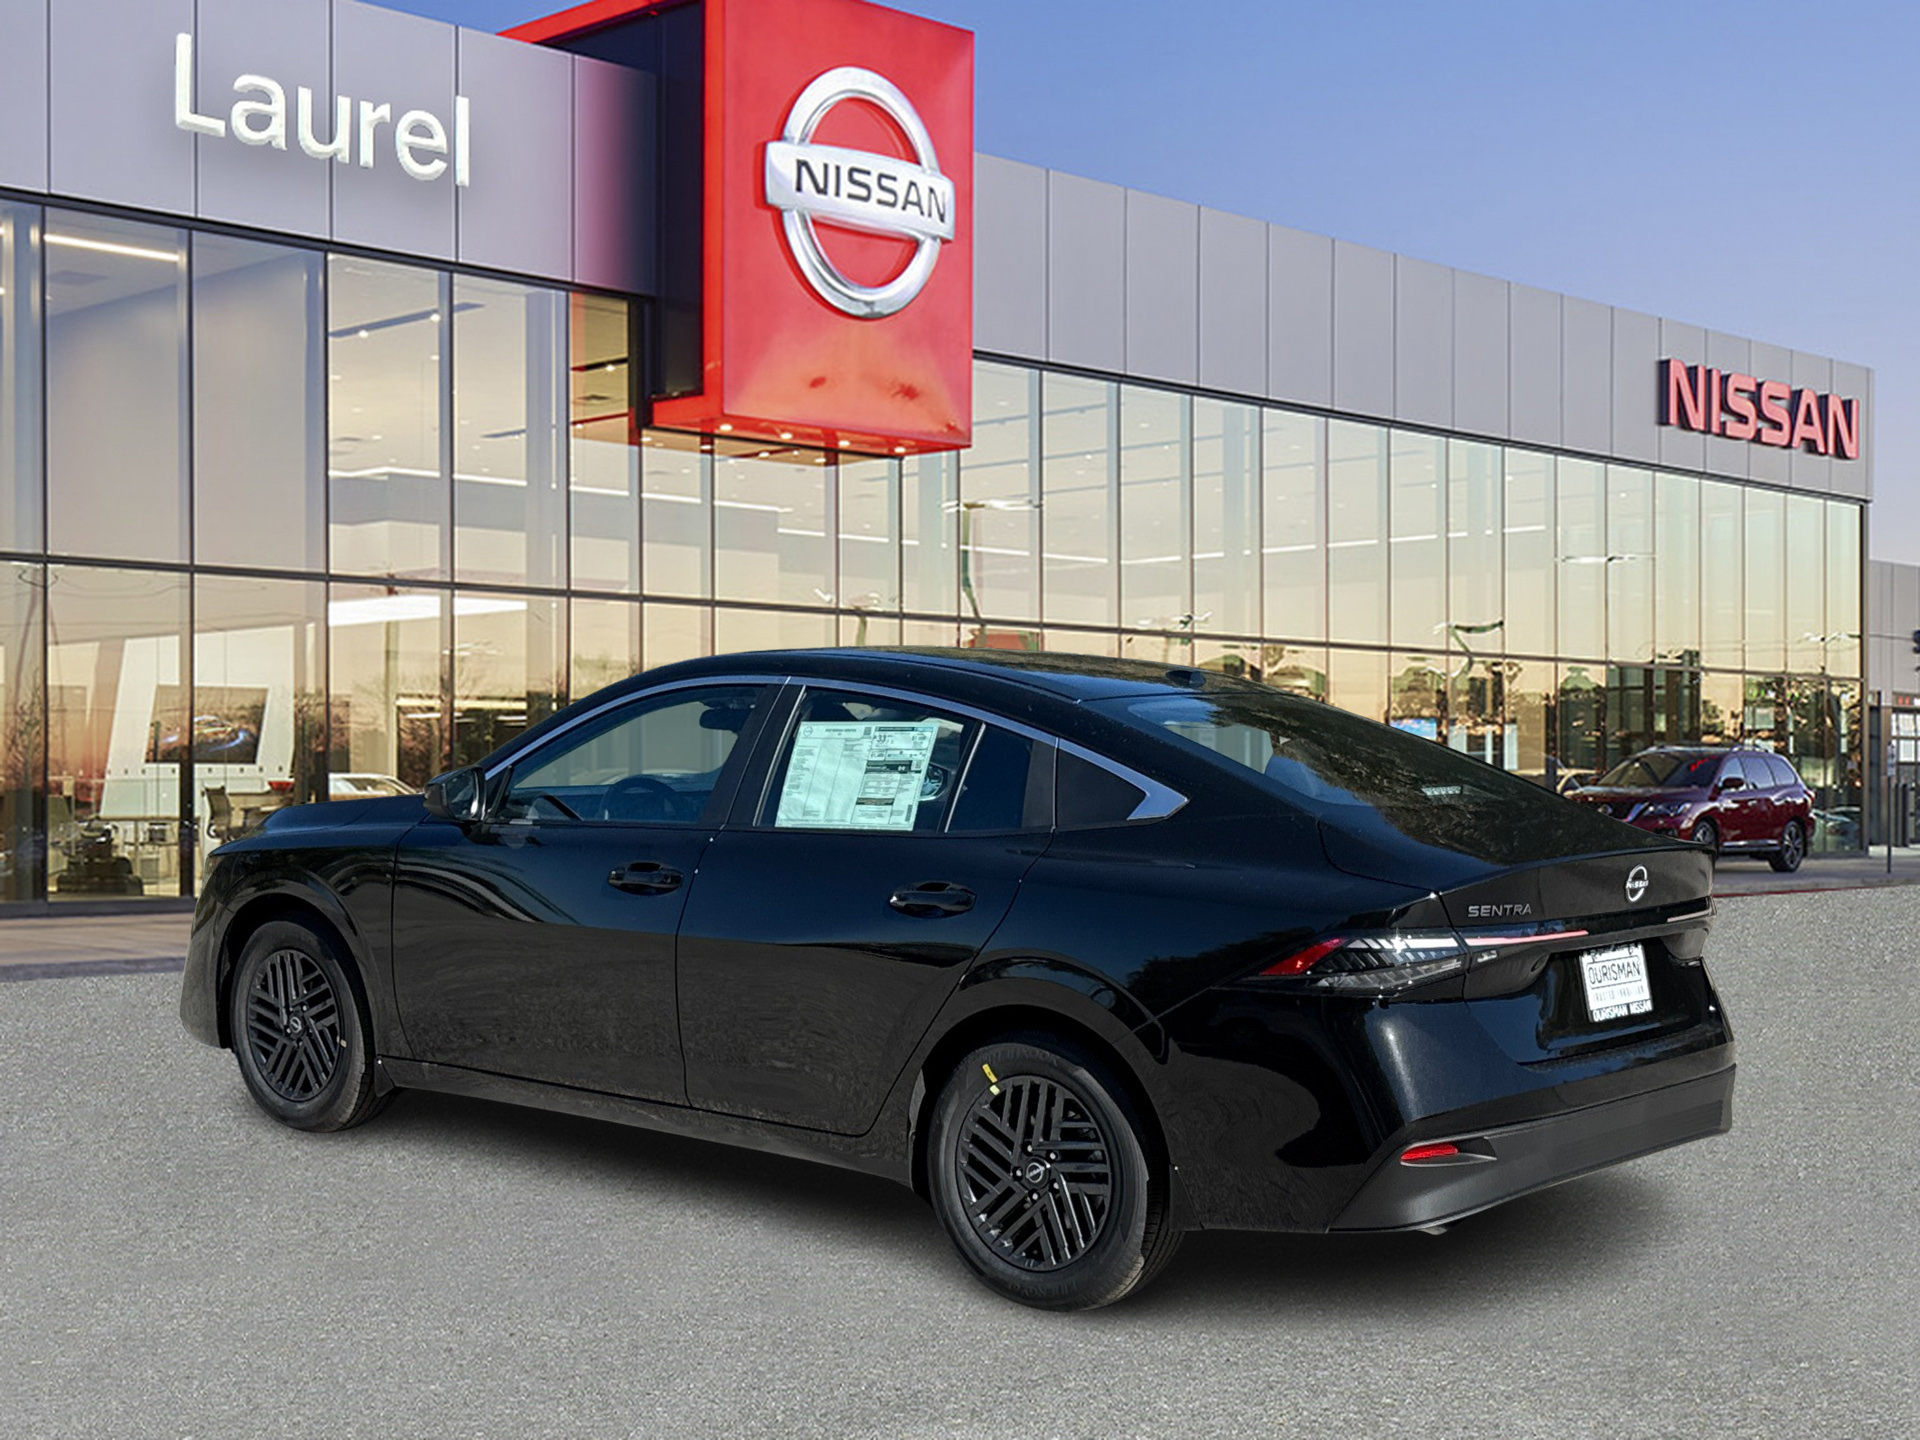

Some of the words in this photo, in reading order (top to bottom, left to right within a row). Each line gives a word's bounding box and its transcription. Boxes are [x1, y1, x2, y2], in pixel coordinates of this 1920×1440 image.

[175, 32, 470, 187] Laurel
[796, 159, 946, 223] NISSAN
[1659, 358, 1860, 459] NISSAN
[1467, 903, 1532, 918] SENTRA
[1588, 961, 1641, 985] OURISMAN
